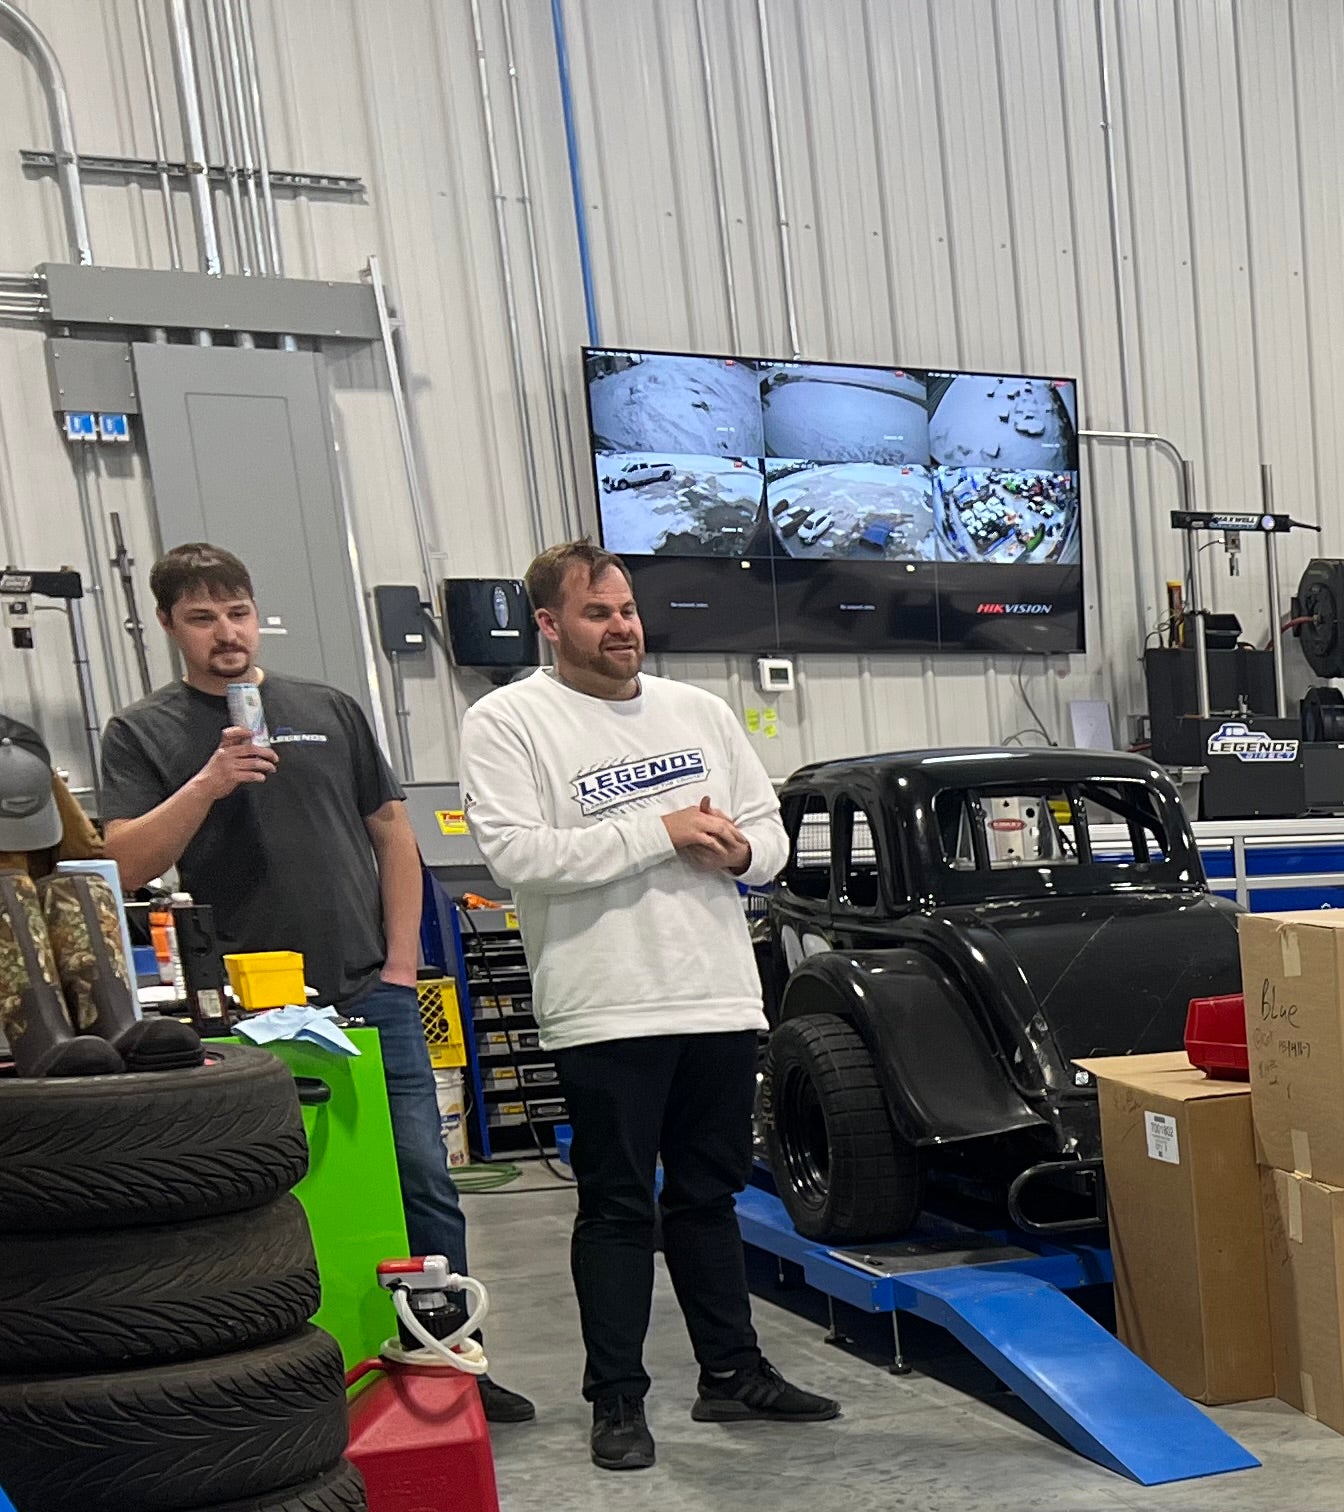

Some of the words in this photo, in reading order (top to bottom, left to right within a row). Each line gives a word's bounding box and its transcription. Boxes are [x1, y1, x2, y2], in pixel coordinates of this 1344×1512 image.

[977, 604, 1052, 613] HIKVISION
[269, 734, 327, 744] LEGENDS
[1210, 742, 1296, 752] LEGENDS
[579, 752, 702, 796] LEGENDS
